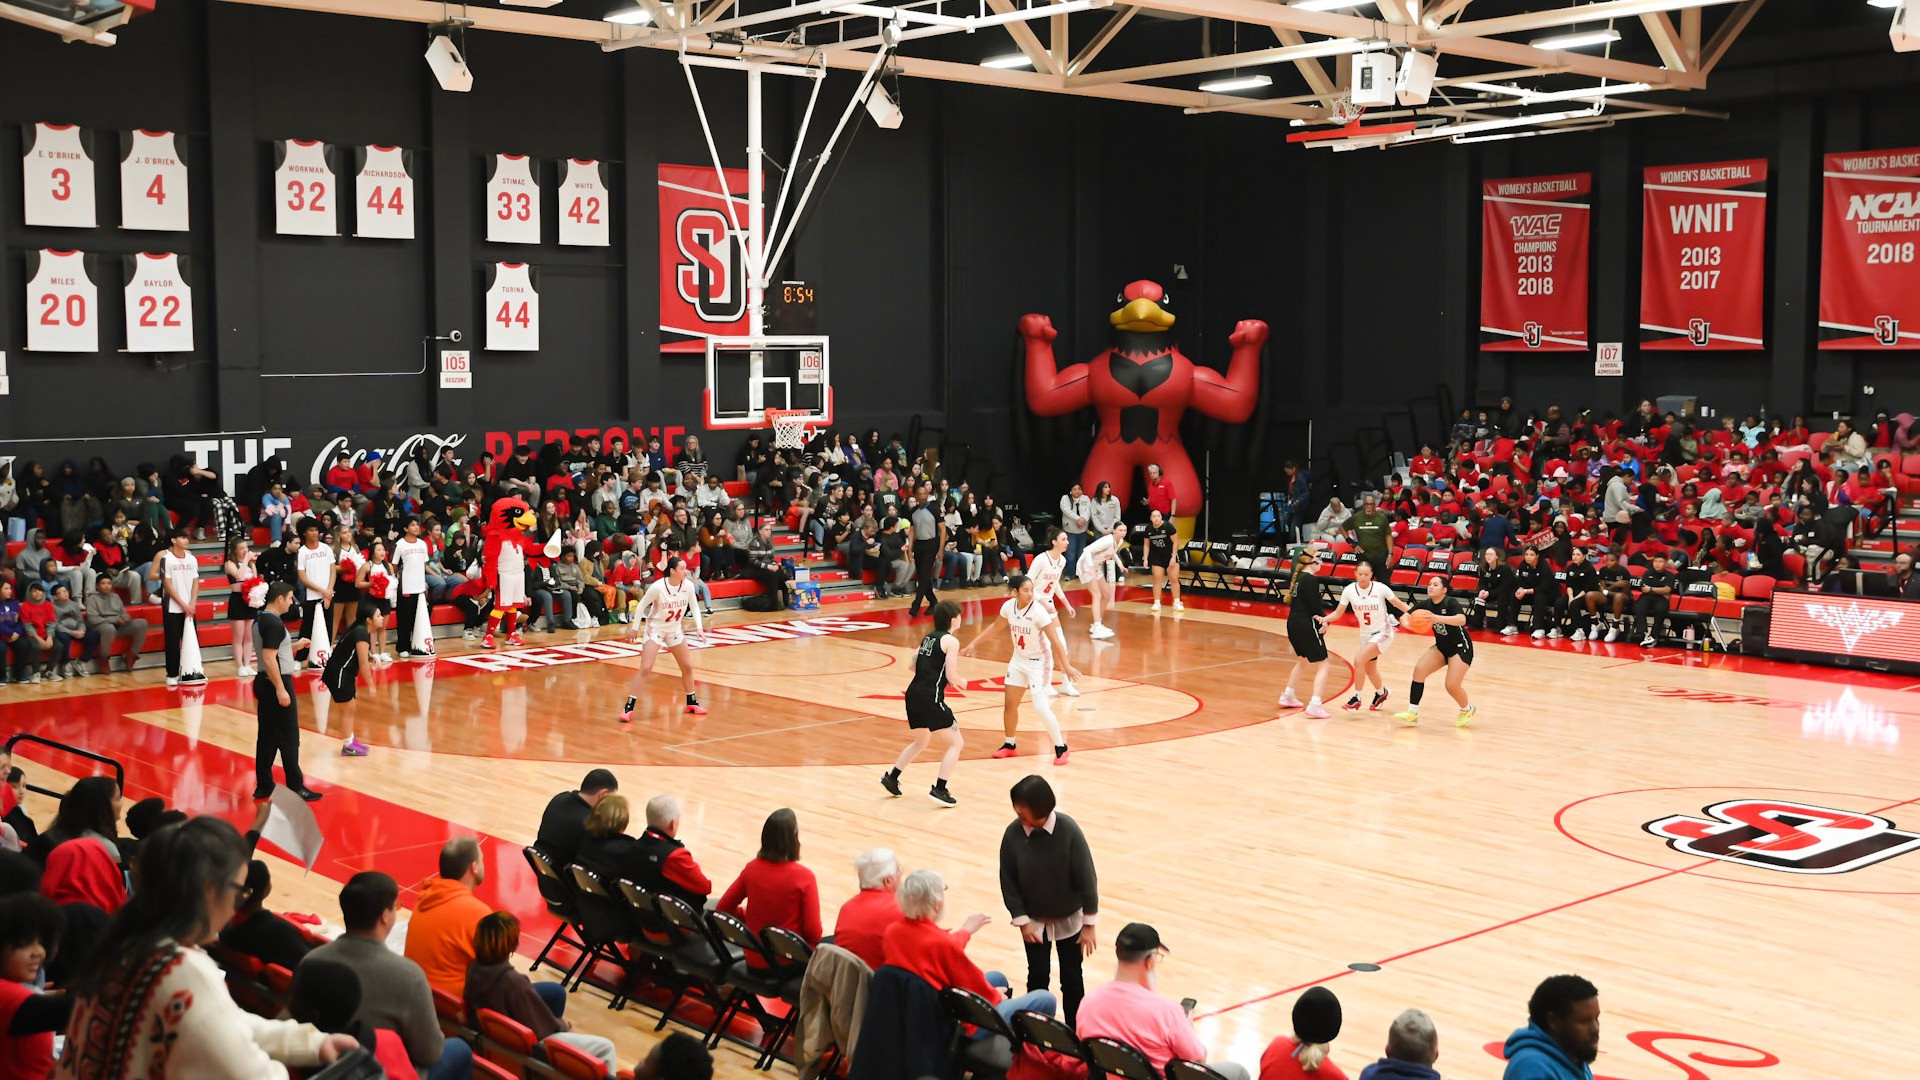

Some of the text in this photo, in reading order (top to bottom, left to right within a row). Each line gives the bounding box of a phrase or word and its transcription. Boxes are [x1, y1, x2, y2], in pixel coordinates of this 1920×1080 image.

[48, 151, 82, 160] O'BRIEN
[144, 158, 176, 166] O'BRIEN
[1843, 153, 1920, 171] WOMEN'S BASKE
[288, 165, 324, 174] WORKMAN
[364, 169, 406, 178] RICHARDSON
[1660, 166, 1752, 184] WOMEN'S BASKETBALL
[51, 168, 71, 201] 3
[502, 178, 526, 186] STIMAC
[1498, 178, 1578, 196] WOMEN'S BASKETBALL
[146, 174, 166, 205] 4
[287, 180, 326, 212] 32
[367, 186, 404, 215] 44
[497, 191, 531, 222] 33
[568, 196, 600, 224] 42
[1510, 214, 1562, 236] WAC
[1669, 202, 1738, 235] WNIT
[1857, 218, 1920, 234] TOURNAMENT
[1514, 240, 1557, 254] CHAMPIONS
[1866, 242, 1914, 264] 2018
[1680, 246, 1722, 266] 2013
[50, 278, 76, 286] MILES
[144, 280, 174, 288] BAYLOR
[1518, 278, 1554, 296] 2018
[1680, 270, 1720, 290] 2017
[502, 286, 524, 294] TURINA
[784, 286, 814, 304] 8:54
[40, 293, 86, 327] 20
[138, 295, 181, 327] 22
[496, 300, 530, 328] 44
[1600, 348, 1618, 360] 107
[446, 356, 466, 370] 105
[803, 356, 820, 368] 106
[1188, 540, 1204, 548] SEATTLE
[1212, 542, 1229, 550] SEATTLE
[1236, 544, 1253, 552] SEATTLE
[1260, 546, 1278, 554] SEATTLE
[1341, 553, 1358, 562] SEATTL
[1399, 558, 1418, 567] SEATTLE
[1428, 561, 1448, 570] SEATTLE
[1458, 564, 1478, 572] SEATTLE
[1044, 582, 1054, 594] 6
[1688, 584, 1713, 592] SEATTLE
[665, 609, 682, 622] 24
[1364, 612, 1371, 626] 5
[441, 616, 890, 672] REDAWKS
